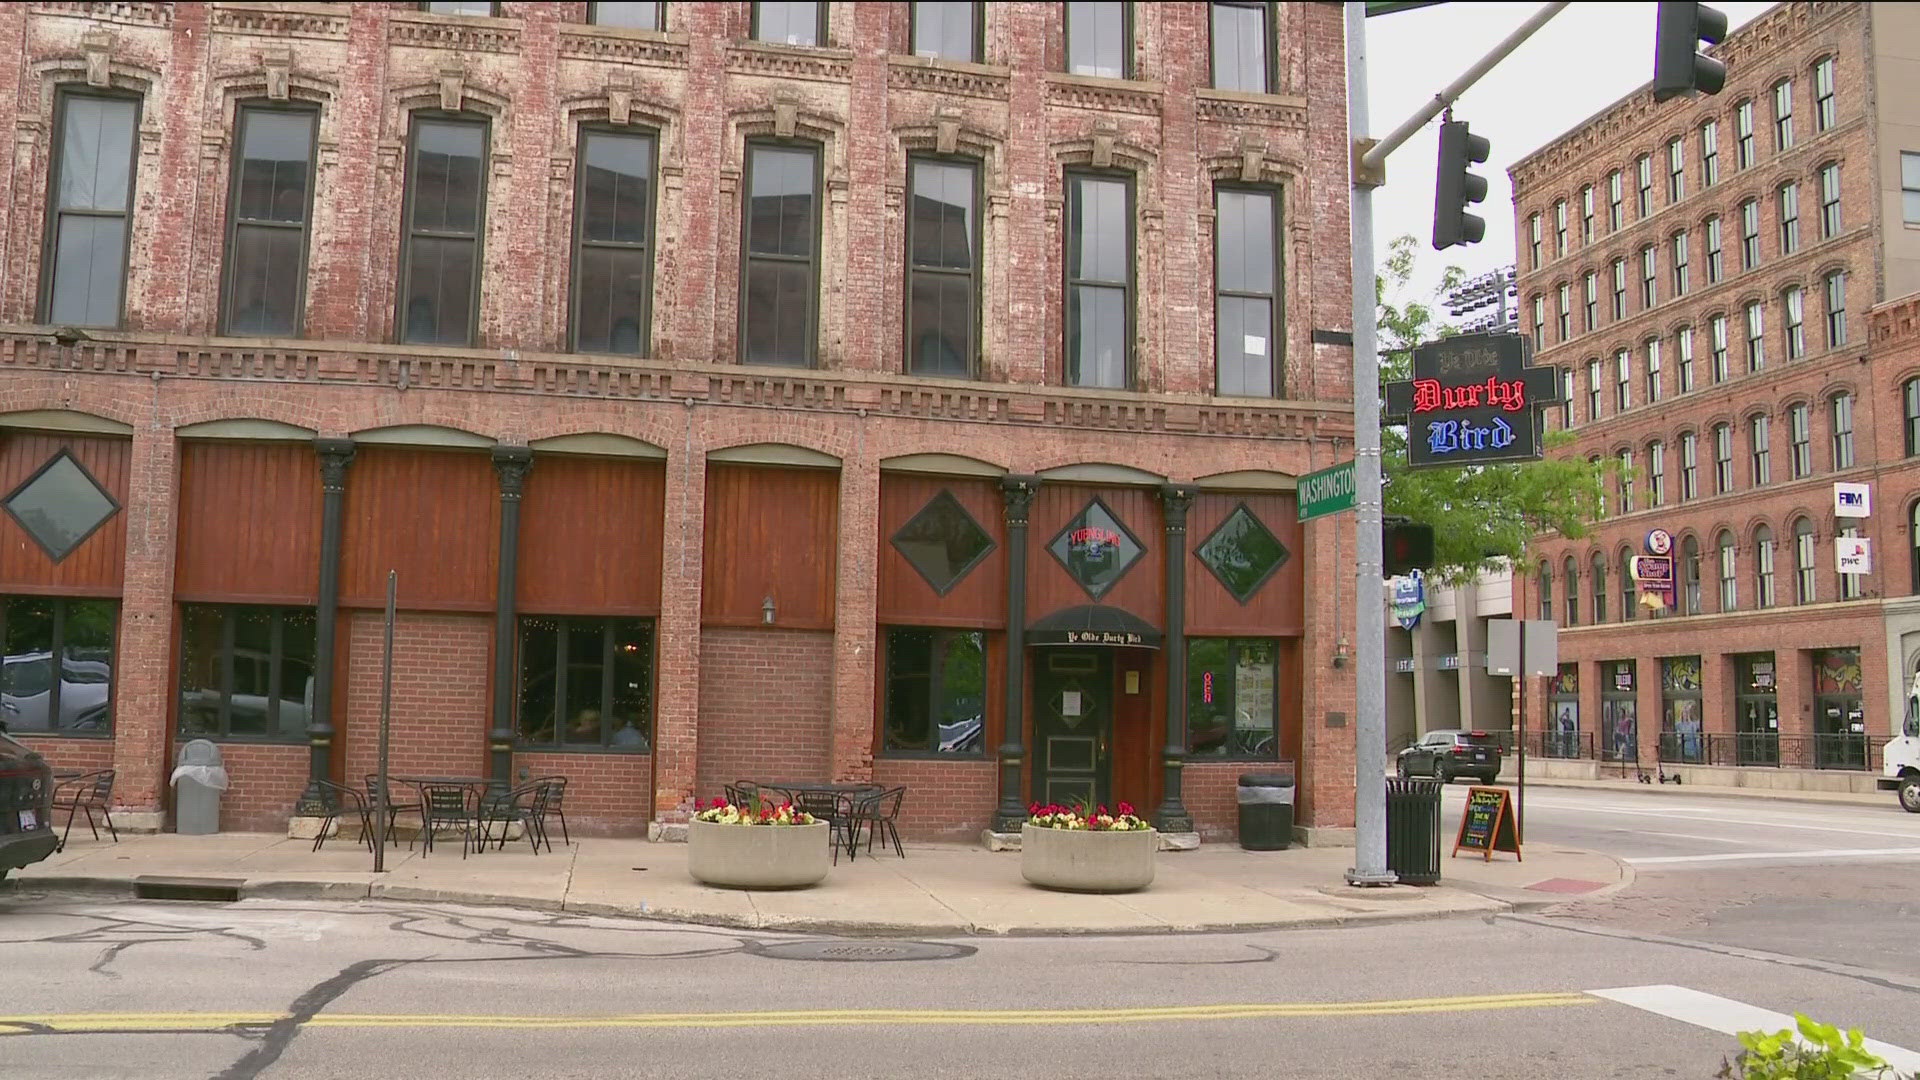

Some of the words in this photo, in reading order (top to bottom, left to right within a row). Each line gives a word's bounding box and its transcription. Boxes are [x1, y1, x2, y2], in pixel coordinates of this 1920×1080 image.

[1413, 376, 1524, 413] Durty
[1428, 417, 1516, 454] Bird
[1070, 526, 1120, 547] YUENGLING
[1841, 557, 1859, 567] pwc
[1068, 631, 1078, 643] Ye
[1081, 632, 1100, 642] Olde
[1103, 632, 1124, 645] Durty
[1127, 633, 1142, 644] Bird
